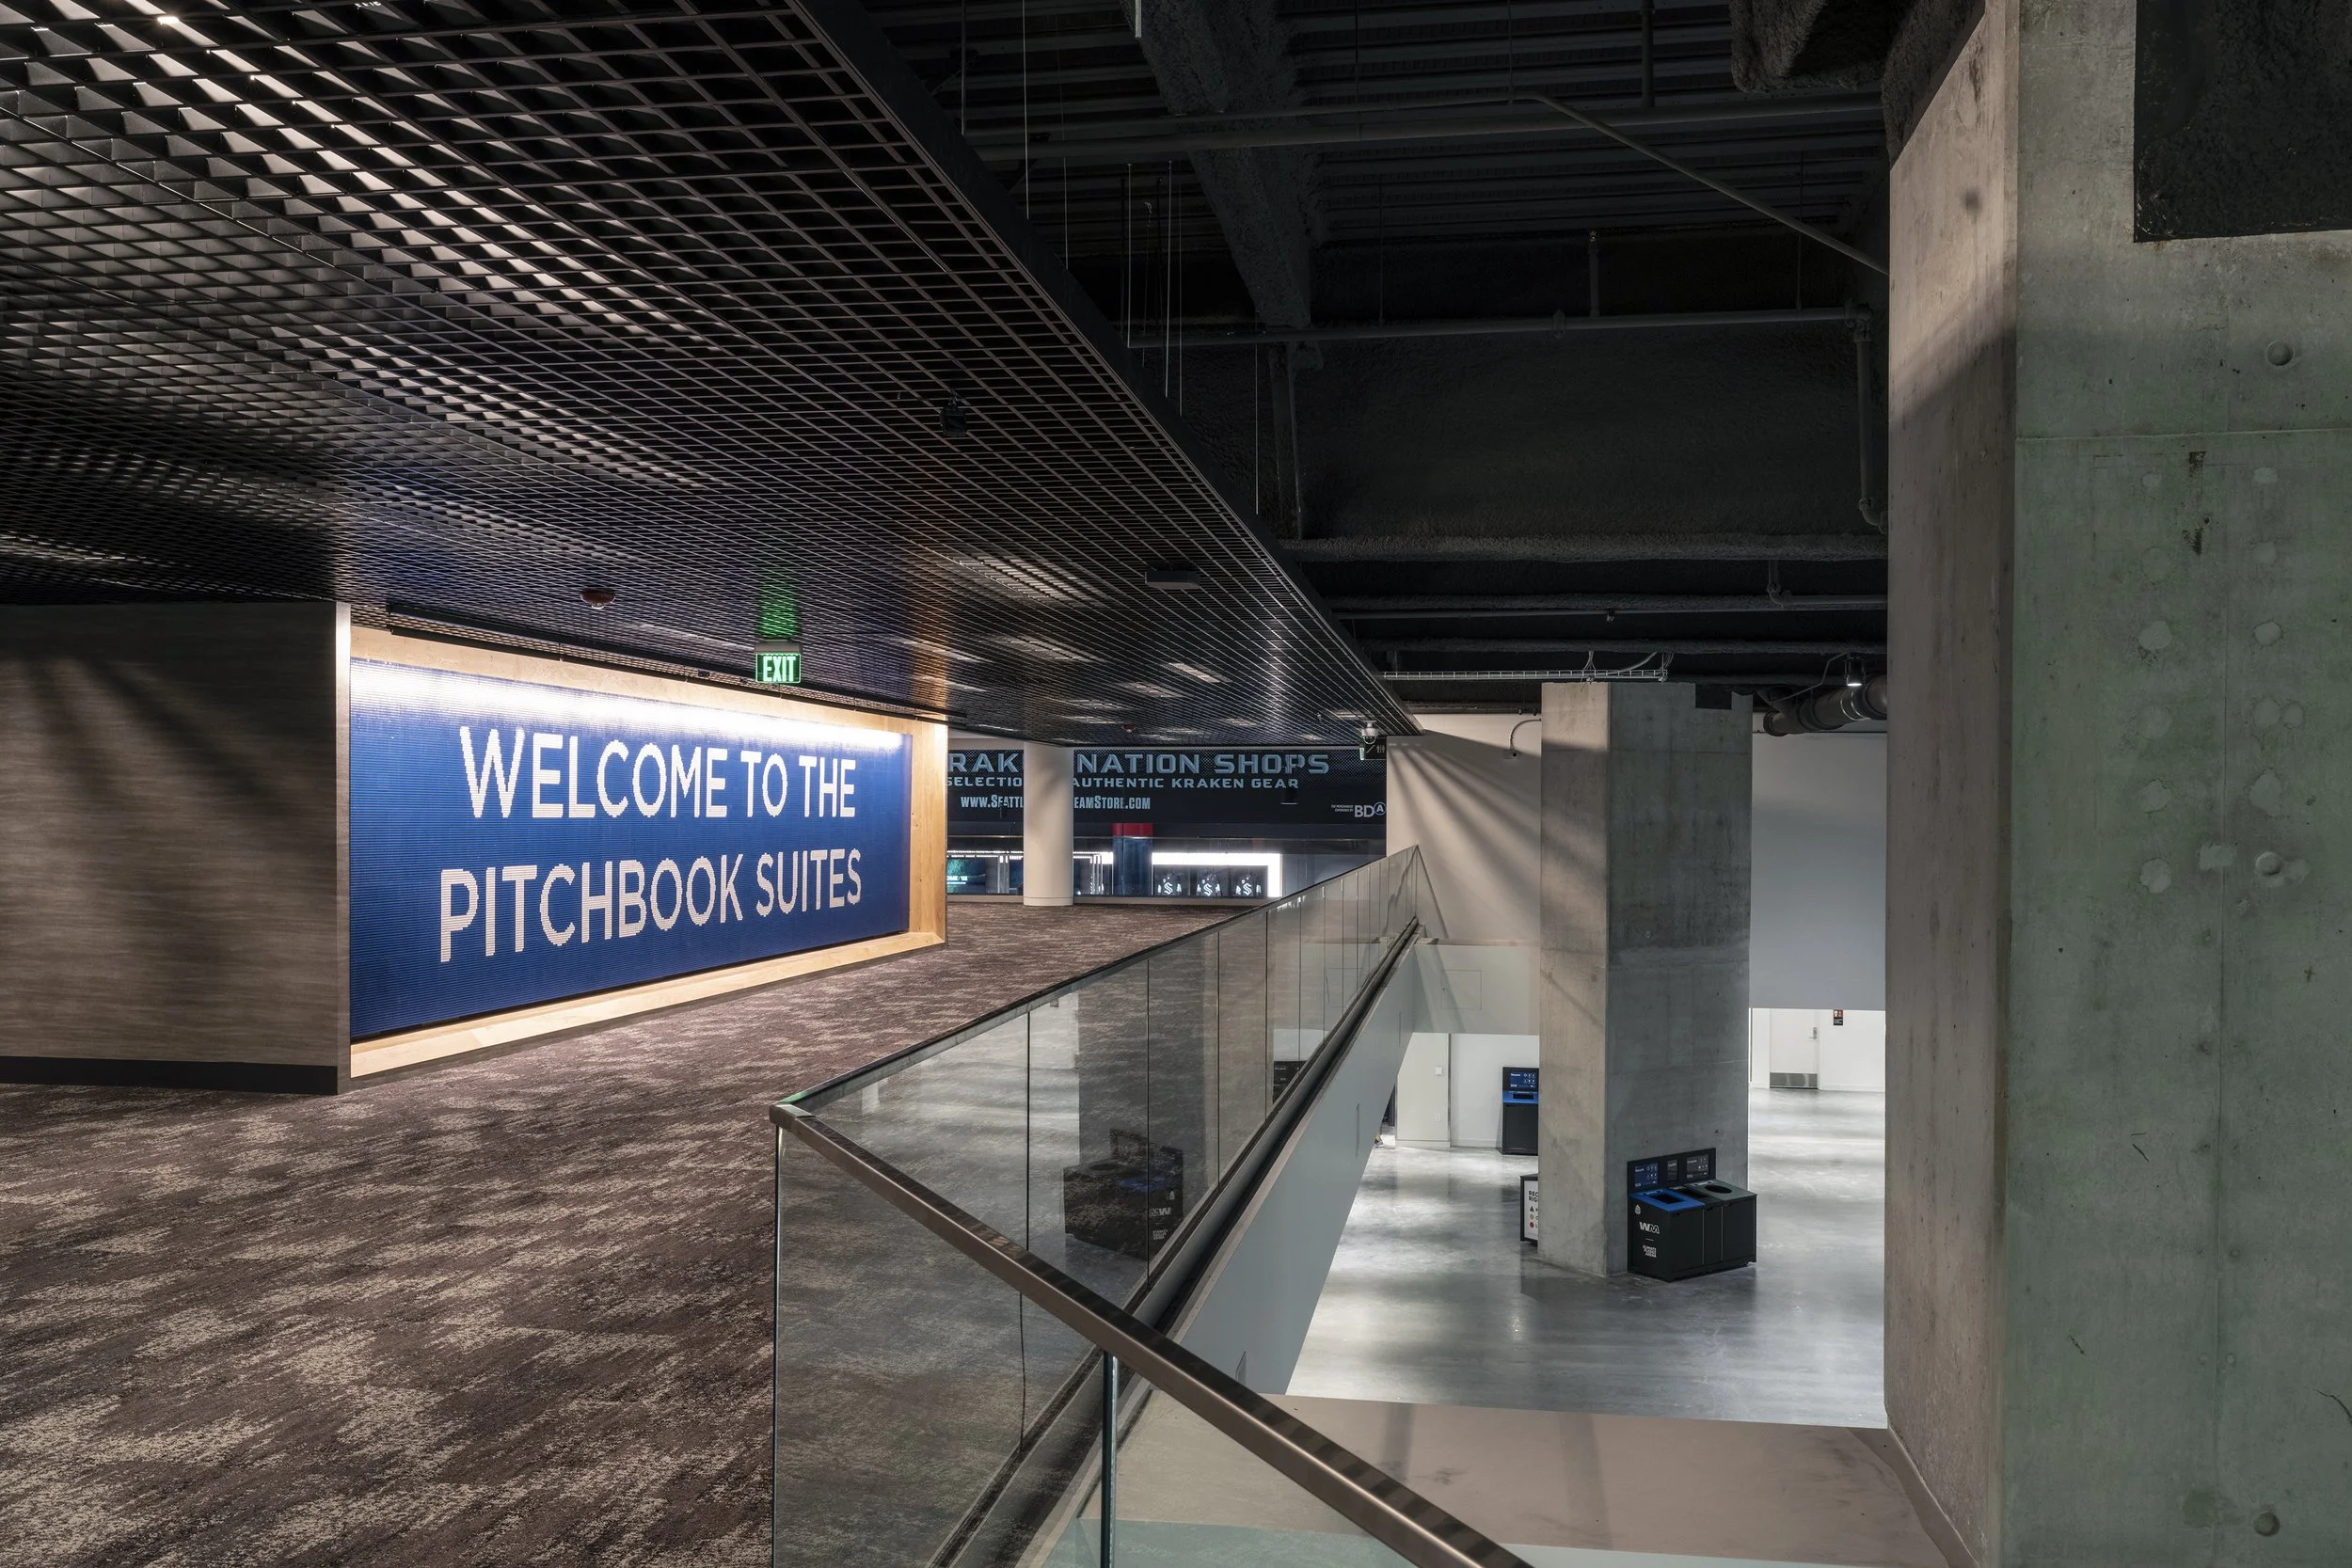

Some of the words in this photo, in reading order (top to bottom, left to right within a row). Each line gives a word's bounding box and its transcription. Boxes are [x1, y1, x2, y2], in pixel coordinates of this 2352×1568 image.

[763, 656, 796, 682] EXIT
[459, 726, 728, 817] WELCOME
[740, 751, 787, 817] TO
[799, 755, 856, 817] THE
[948, 753, 1024, 772] RAK
[1076, 753, 1200, 774] NATION
[1214, 753, 1329, 774] SHOPS
[946, 776, 1023, 786] SELECTIO
[1171, 777, 1244, 788] KRAKEN
[1251, 778, 1298, 788] GEAR
[440, 854, 744, 962] PITCHBOOK
[755, 848, 862, 917] SUITES
[1639, 1221, 1660, 1234] WM
